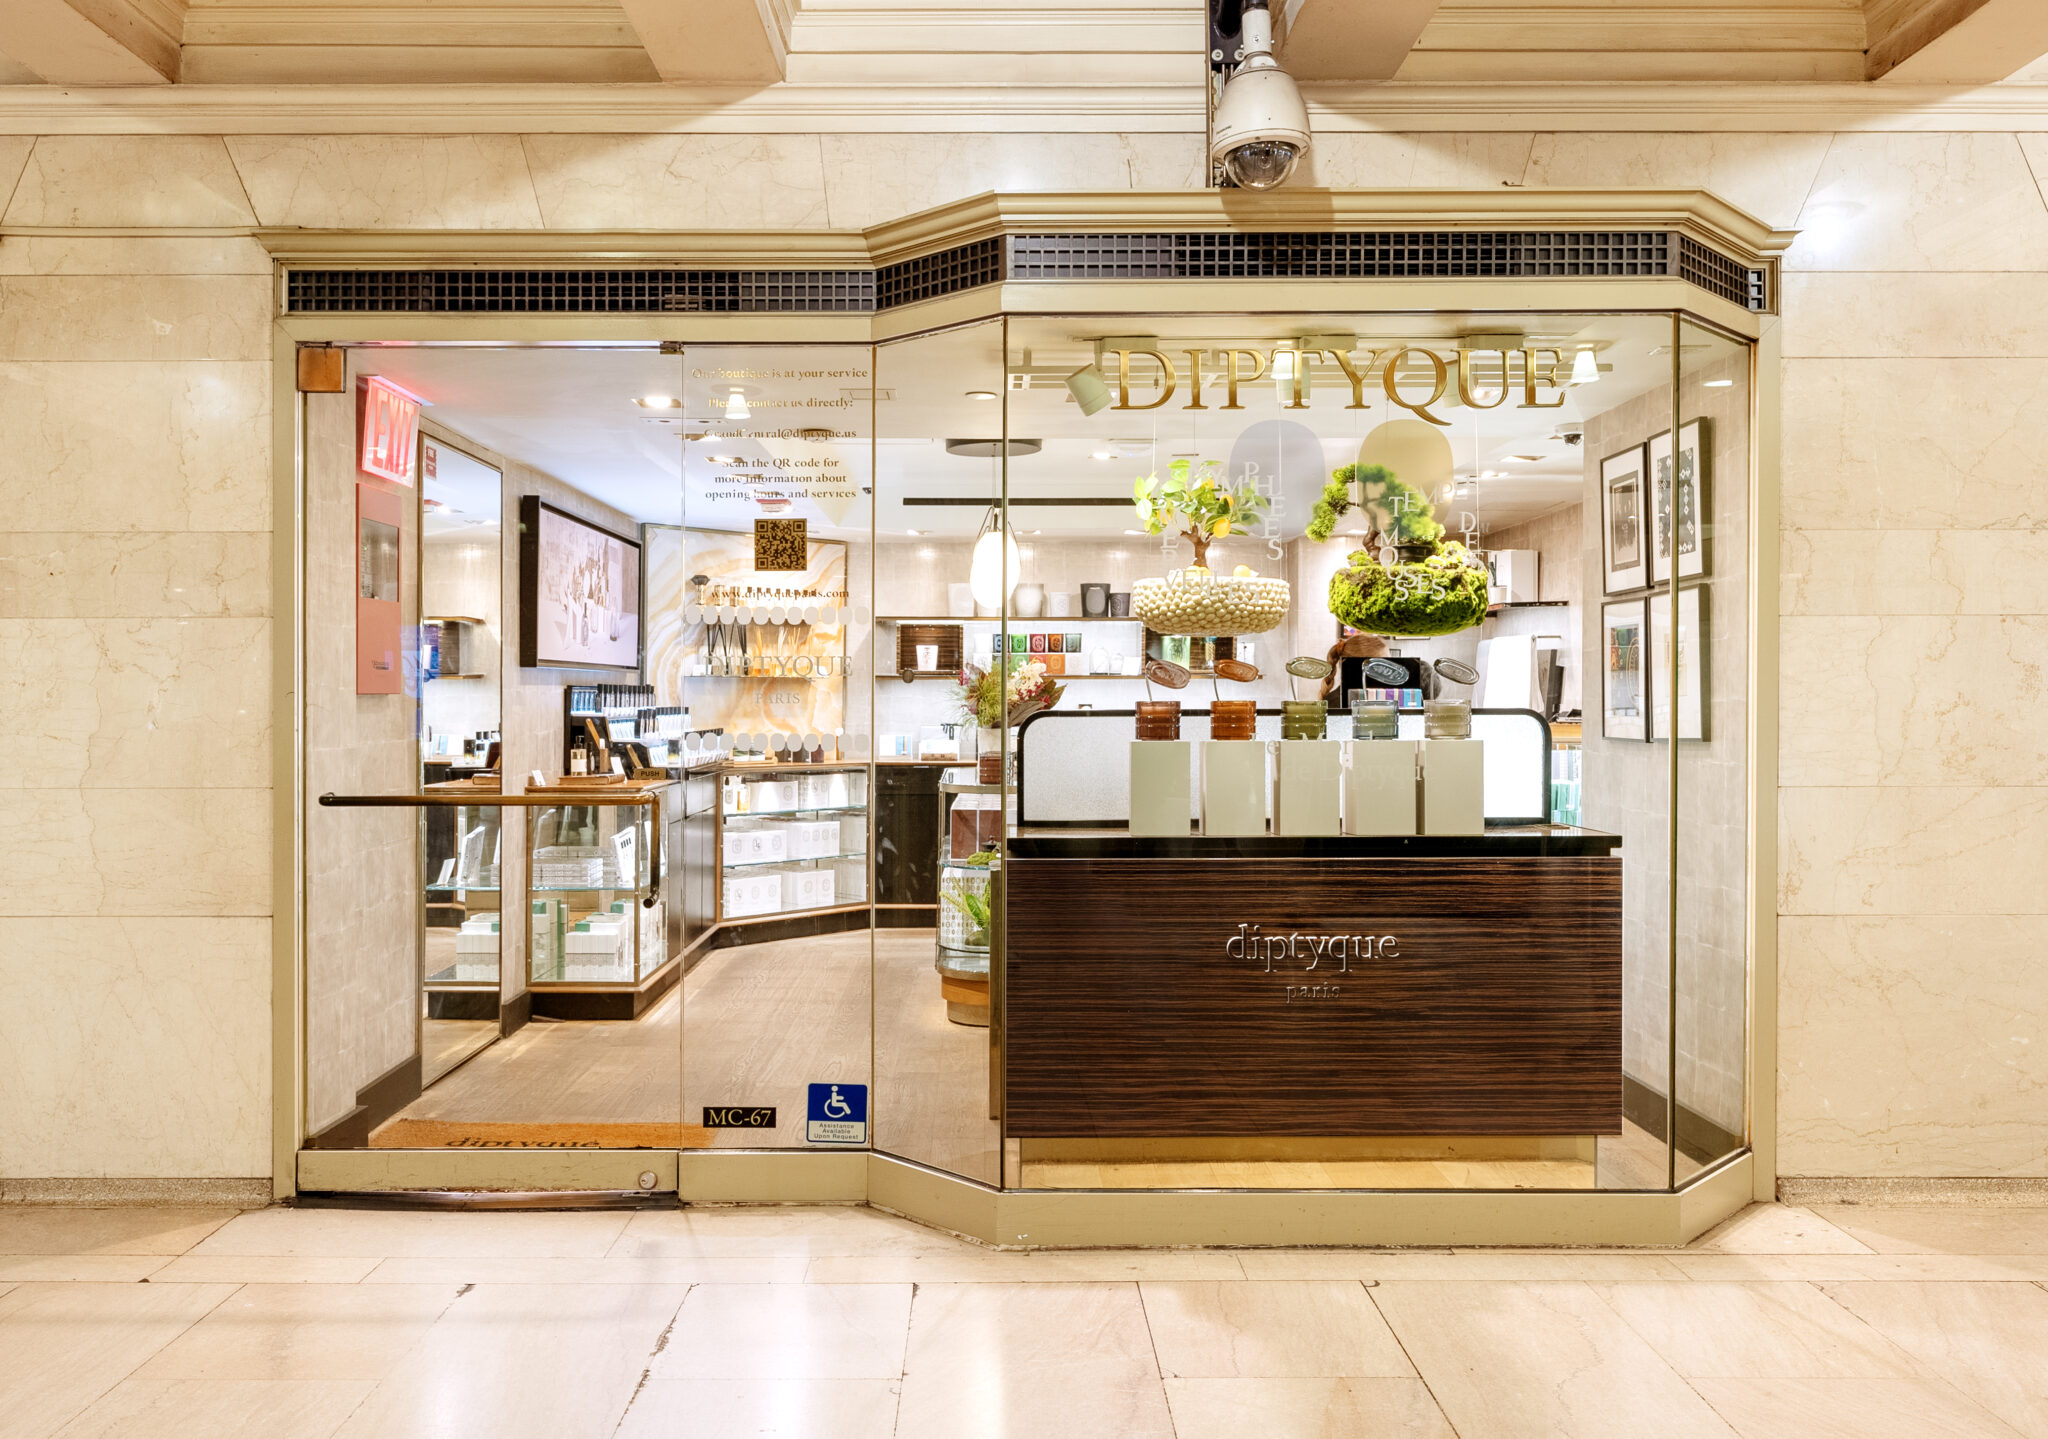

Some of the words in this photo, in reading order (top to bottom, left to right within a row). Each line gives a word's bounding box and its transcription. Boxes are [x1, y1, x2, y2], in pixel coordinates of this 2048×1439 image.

[691, 367, 715, 379] Our
[718, 367, 769, 381] boutique
[772, 368, 781, 378] is
[784, 369, 796, 378] at
[798, 369, 825, 381] your
[827, 367, 868, 378] service
[1110, 346, 1567, 427] DIPTYQUE
[708, 397, 746, 409] Plea
[791, 399, 803, 409] us
[806, 396, 853, 410] directly:
[371, 388, 416, 477] EXIT
[752, 458, 769, 468] the
[773, 457, 790, 470] QR
[794, 457, 819, 468] code
[823, 457, 839, 467] for
[715, 475, 742, 483] more
[746, 472, 812, 483] information
[815, 472, 847, 483] about
[705, 488, 750, 501] opening
[754, 488, 785, 498] hours
[788, 487, 808, 498] and
[811, 488, 857, 498] services
[703, 655, 853, 682] DIPTYQUE
[755, 692, 801, 705] PARIS
[1226, 923, 1400, 973] diptyque
[1286, 981, 1341, 1004] paris
[708, 1108, 772, 1127] MC-67
